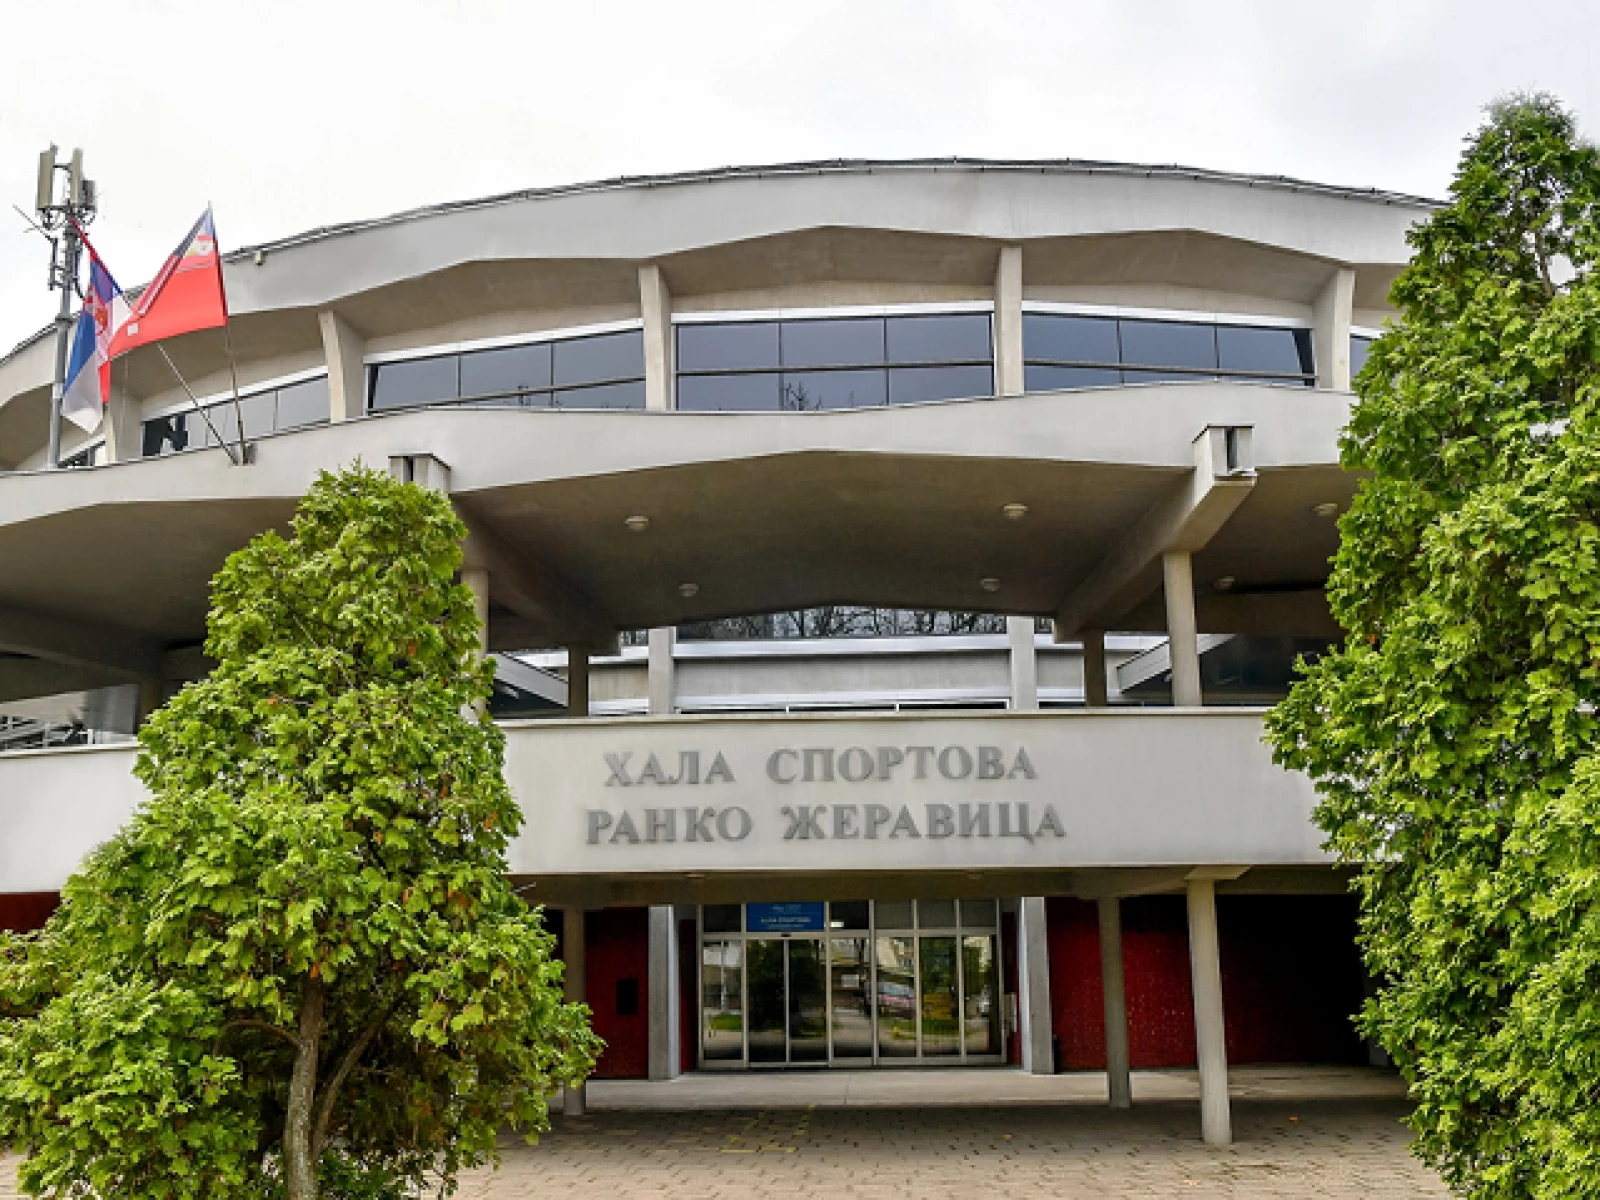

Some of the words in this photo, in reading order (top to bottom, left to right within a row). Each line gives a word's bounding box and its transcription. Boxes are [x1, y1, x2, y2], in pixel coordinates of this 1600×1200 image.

[604, 751, 735, 787] ХАЛА
[766, 746, 1037, 784] СПОРТОВА
[586, 807, 753, 845] РАНКО
[781, 803, 1066, 844] ЖЕРАВИЦА
